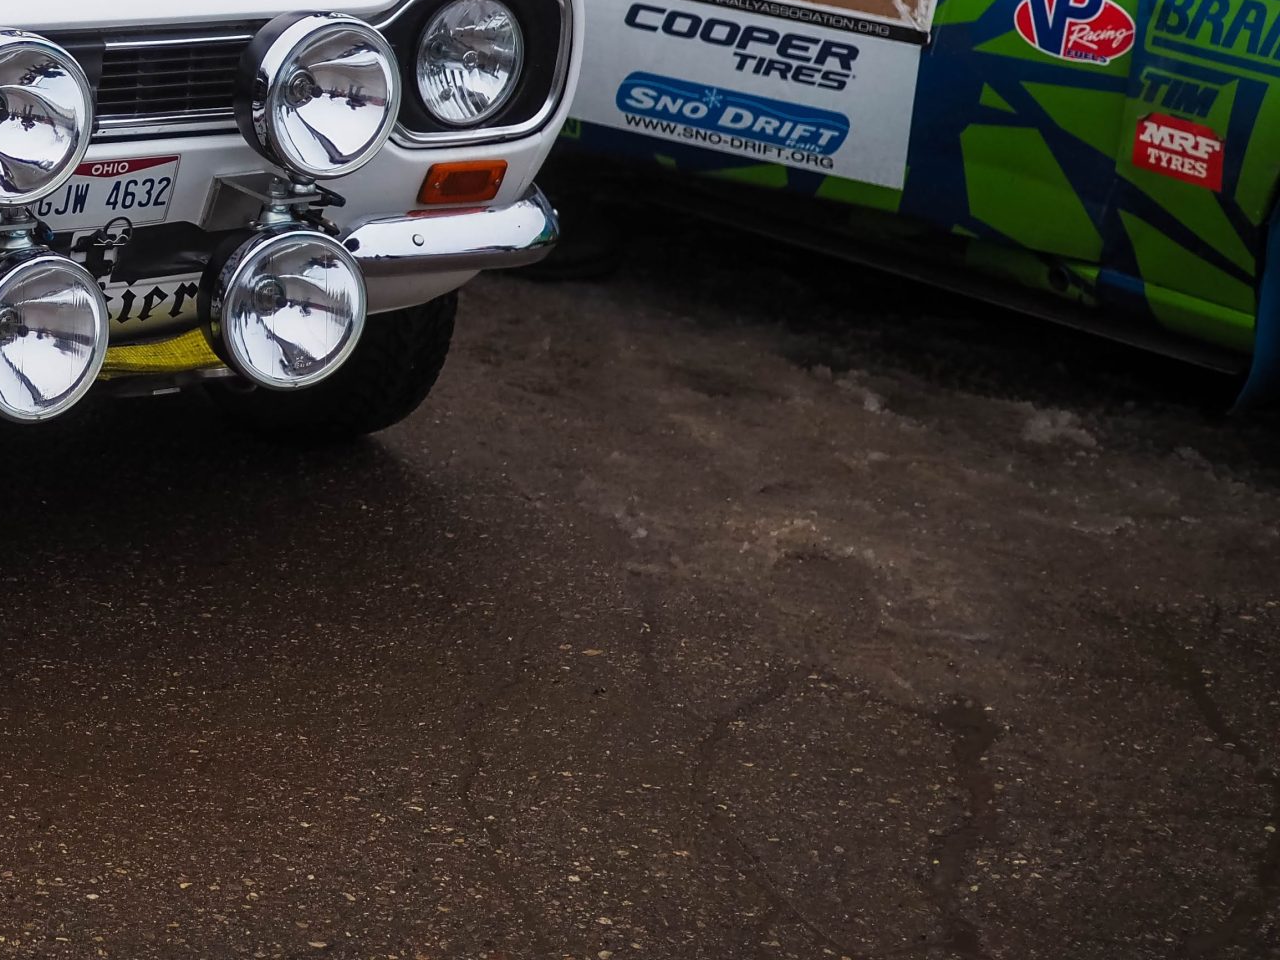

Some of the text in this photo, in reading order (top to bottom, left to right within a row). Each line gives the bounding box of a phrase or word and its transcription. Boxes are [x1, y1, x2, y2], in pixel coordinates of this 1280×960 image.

[624, 3, 860, 72] COOPER
[1067, 23, 1134, 49] Racing
[733, 51, 851, 91] TIRES
[625, 87, 839, 147] SNO DRIFT
[625, 114, 834, 170] WWW.SNO-DRIFT.ORG
[1139, 121, 1221, 160] MRF
[91, 161, 129, 176] OHIO
[1147, 147, 1208, 179] TYRES
[106, 176, 172, 210] 4632
